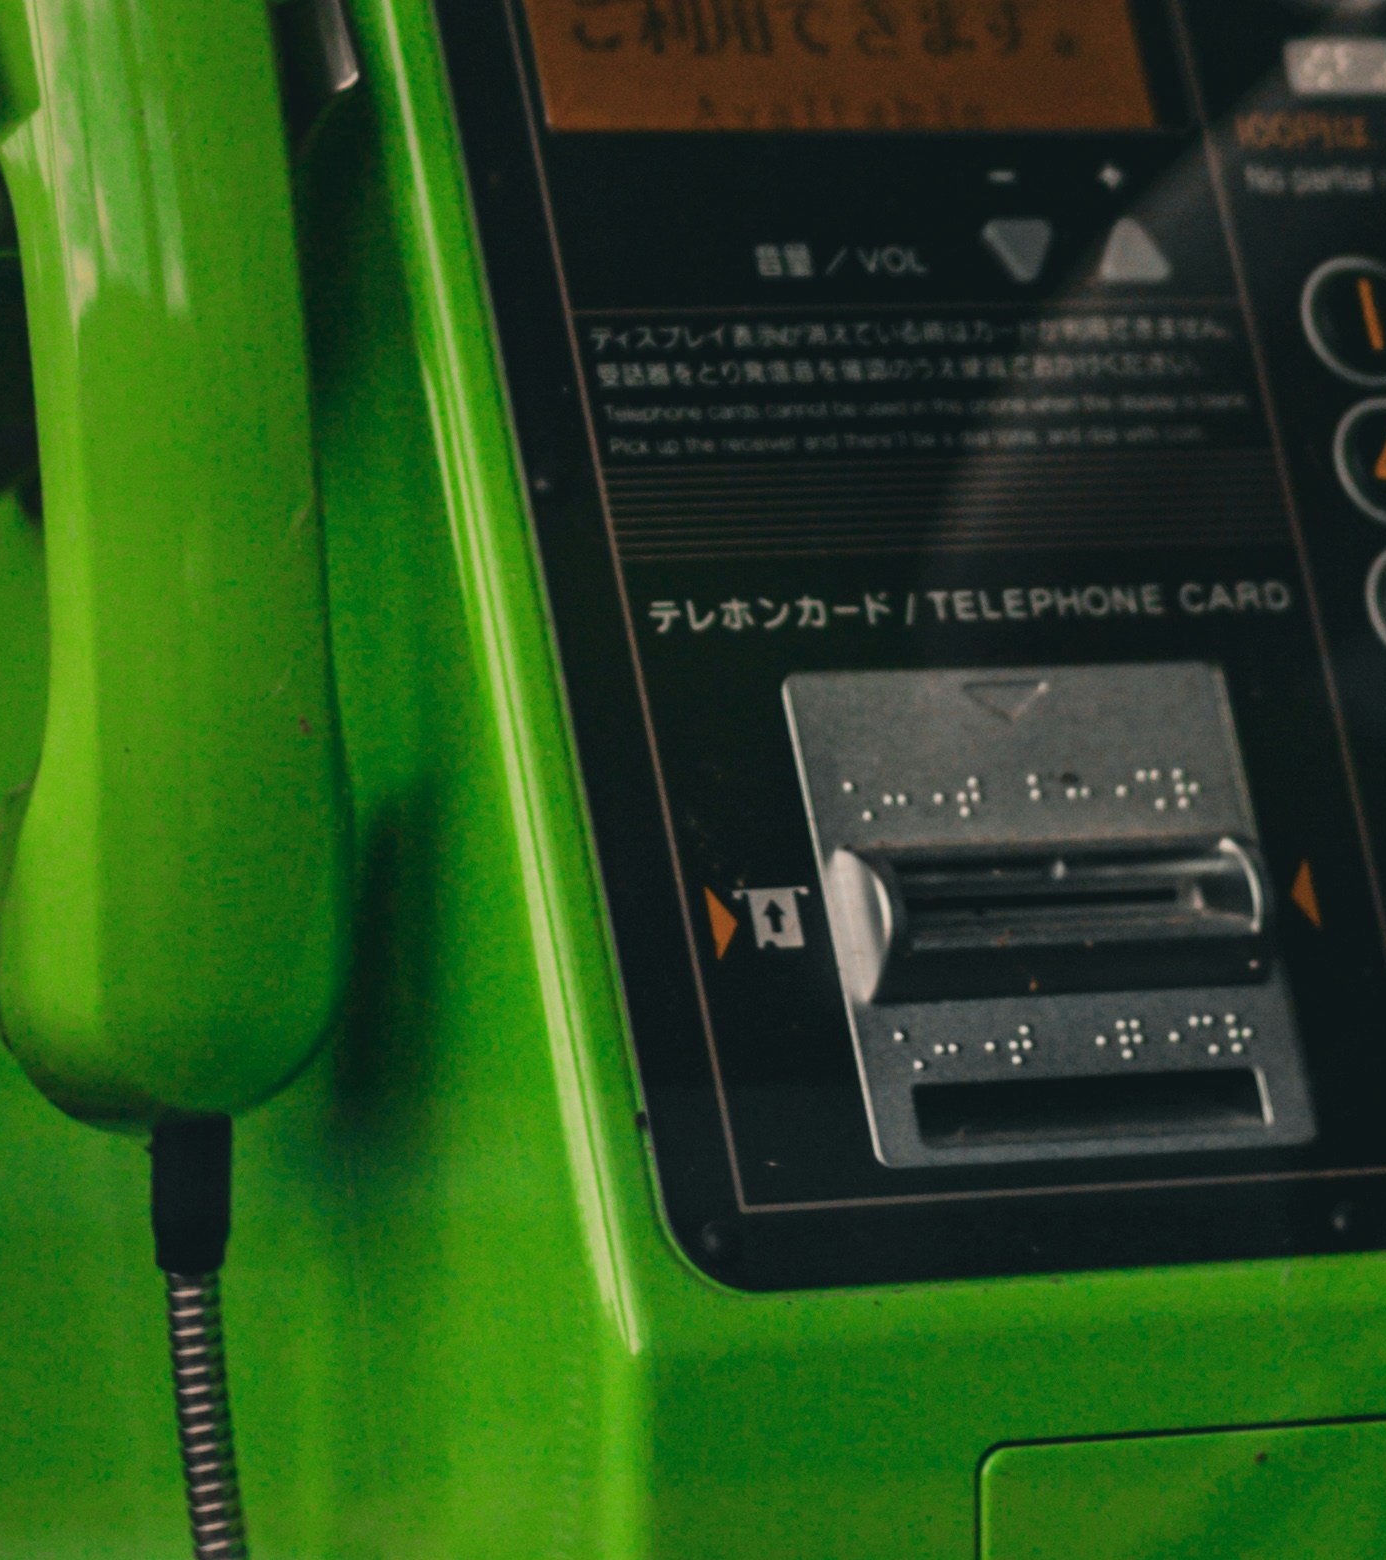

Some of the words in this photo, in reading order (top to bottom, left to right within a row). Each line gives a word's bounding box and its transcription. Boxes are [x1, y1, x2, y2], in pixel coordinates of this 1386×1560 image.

[857, 244, 929, 276] VOL
[1358, 277, 1386, 353] 1
[604, 402, 703, 423] Telephone
[707, 401, 760, 420] cards
[766, 400, 826, 418] cannot
[833, 399, 856, 417] be
[608, 437, 649, 455] Pick
[685, 436, 715, 453] the
[721, 434, 795, 453] receiver
[649, 590, 891, 634] テレホンカード
[929, 584, 1165, 621] TELEPHONE
[1179, 580, 1291, 614] CARD
